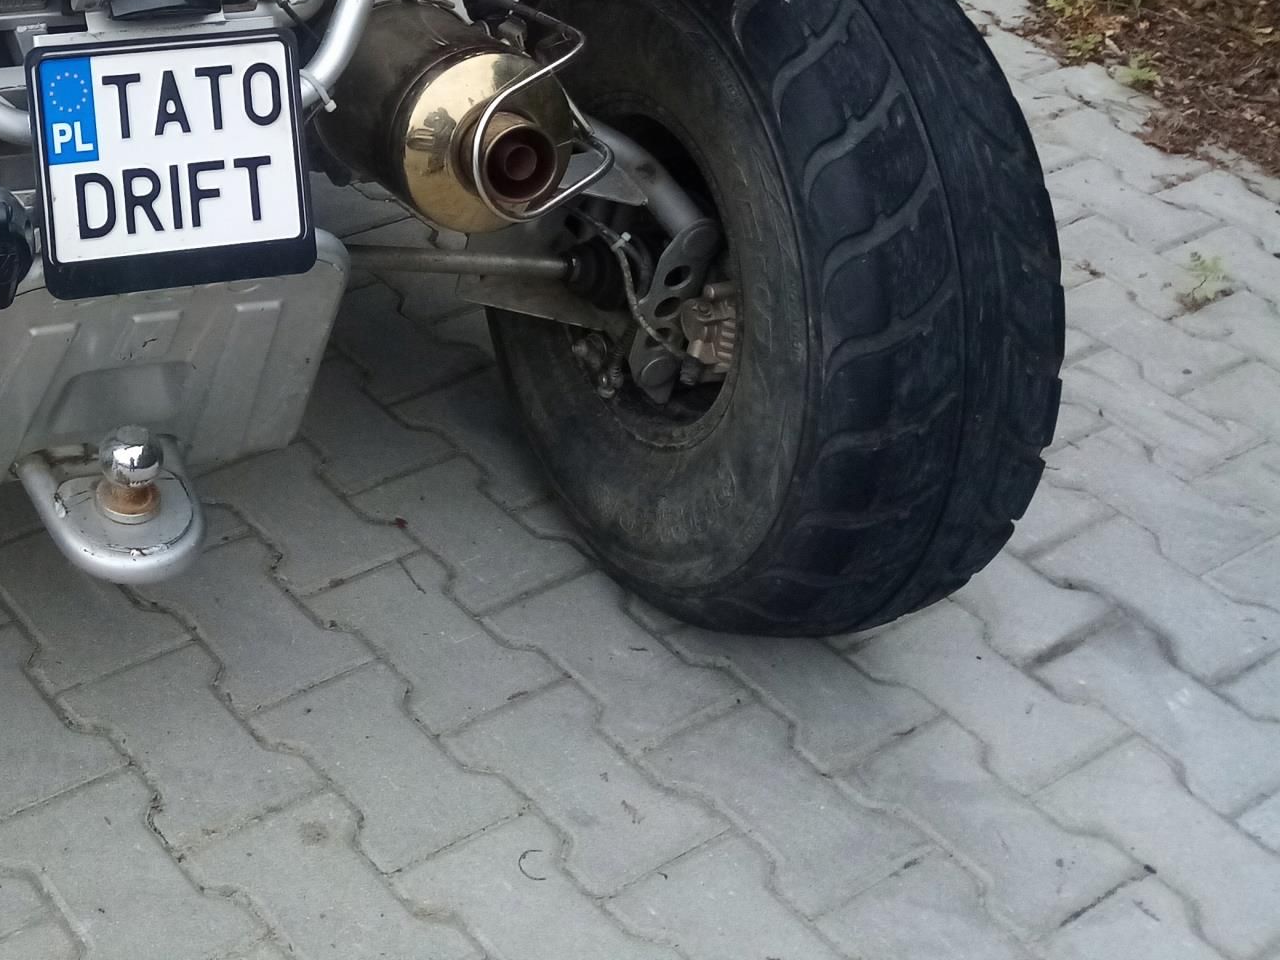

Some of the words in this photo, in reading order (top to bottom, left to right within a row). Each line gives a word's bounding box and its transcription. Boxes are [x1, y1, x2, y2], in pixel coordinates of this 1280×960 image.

[52, 121, 94, 155] PL
[101, 62, 282, 139] TATO
[74, 155, 272, 240] DRIFT
